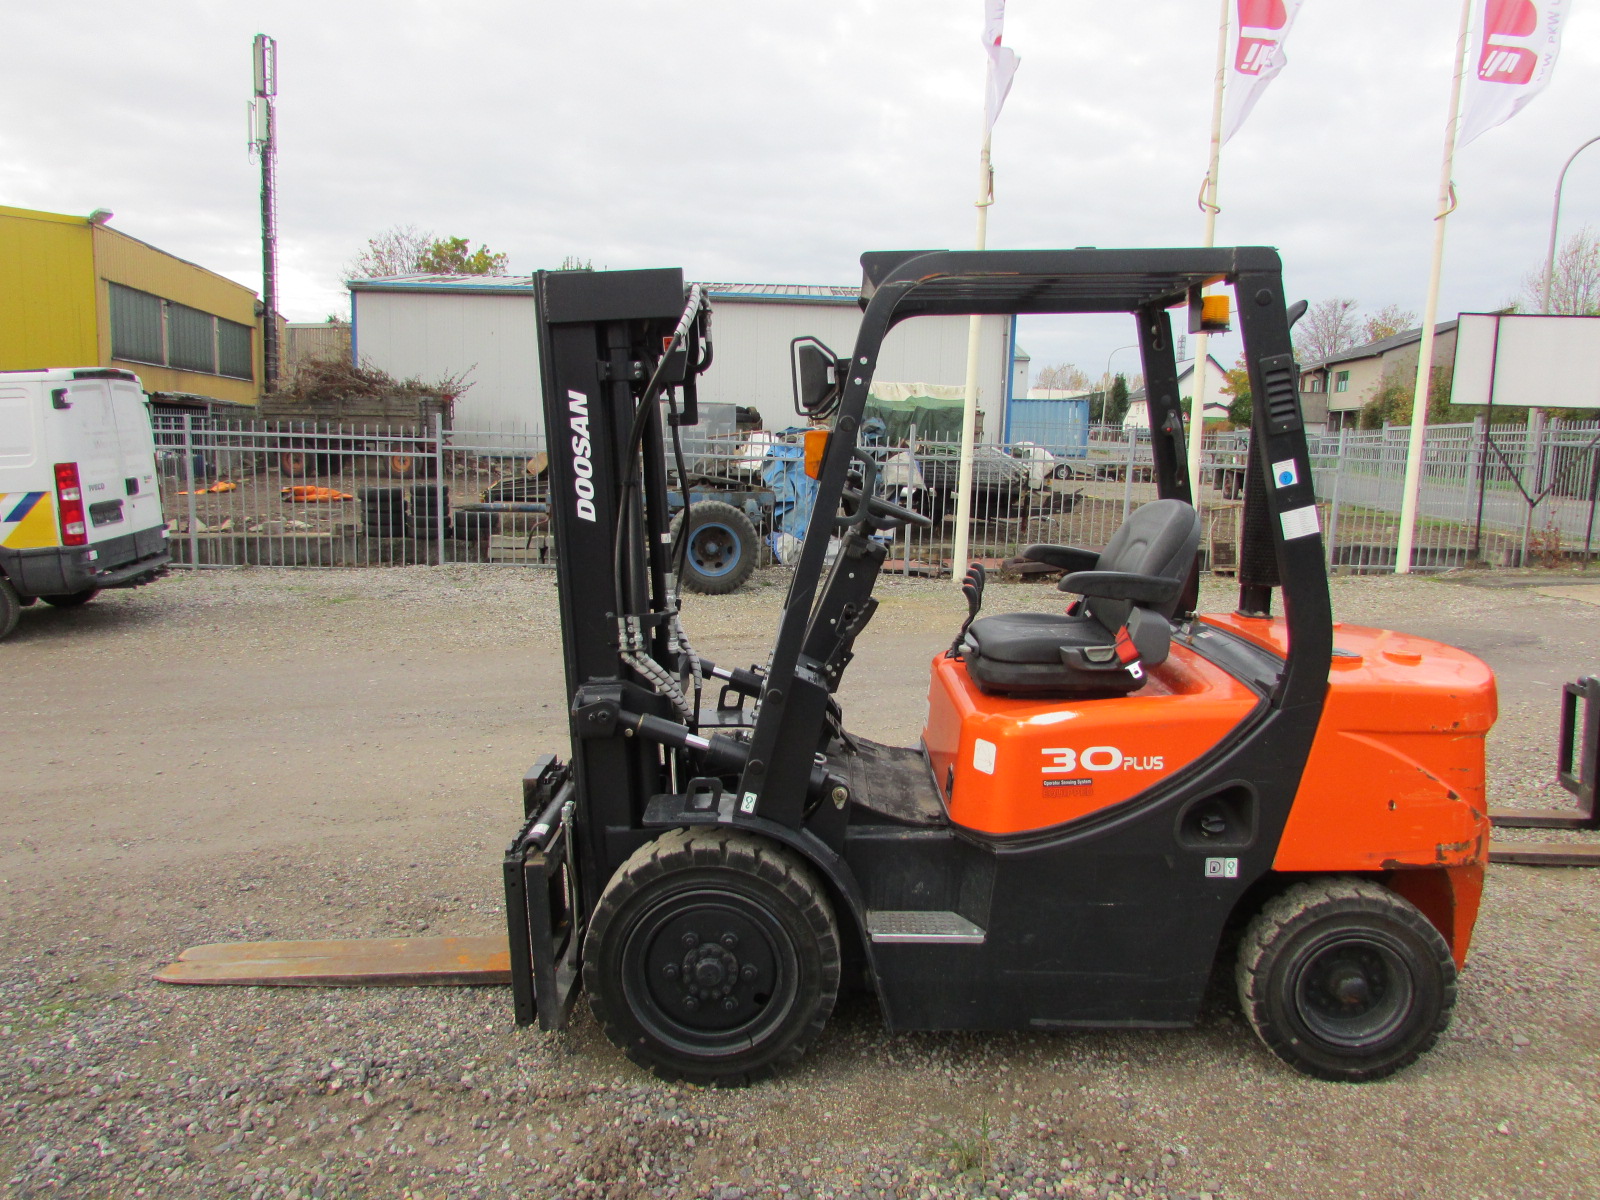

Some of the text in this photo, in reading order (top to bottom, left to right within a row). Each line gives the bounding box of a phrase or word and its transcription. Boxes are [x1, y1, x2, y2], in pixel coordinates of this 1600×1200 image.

[567, 389, 596, 522] DOOSAN
[88, 482, 105, 492] IVECO
[1041, 746, 1164, 773] 30 PLUS
[1042, 787, 1094, 798] EQUIPPED
